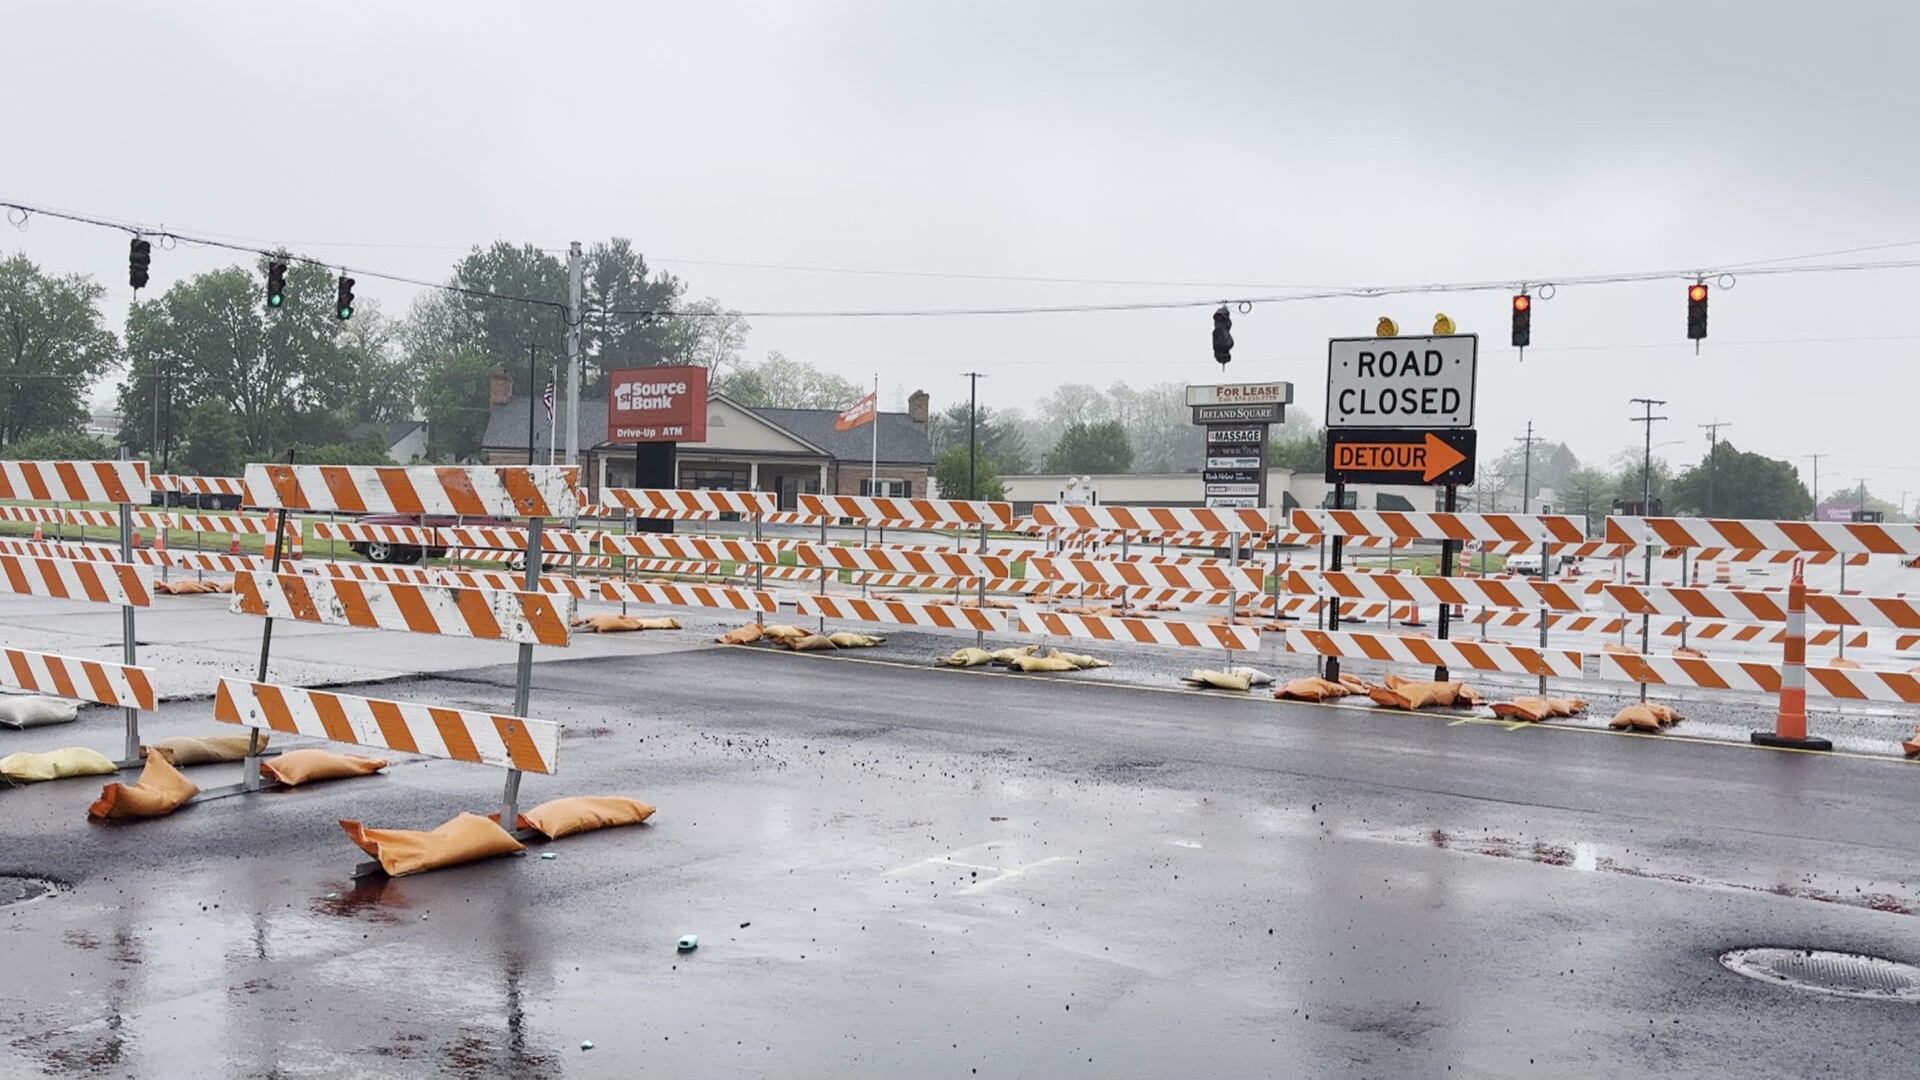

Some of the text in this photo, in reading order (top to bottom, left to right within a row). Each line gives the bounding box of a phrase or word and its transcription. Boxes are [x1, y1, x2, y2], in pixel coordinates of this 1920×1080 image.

[1358, 350, 1443, 378] ROAD
[632, 382, 686, 396] Source
[632, 395, 673, 410] Bank
[1339, 388, 1461, 415] CLOSED
[1199, 408, 1272, 419] IRELAND SQUARE
[617, 427, 683, 438] Drive-Up ATM
[1215, 431, 1260, 442] MASSAGE
[1340, 447, 1427, 467] DETOUR
